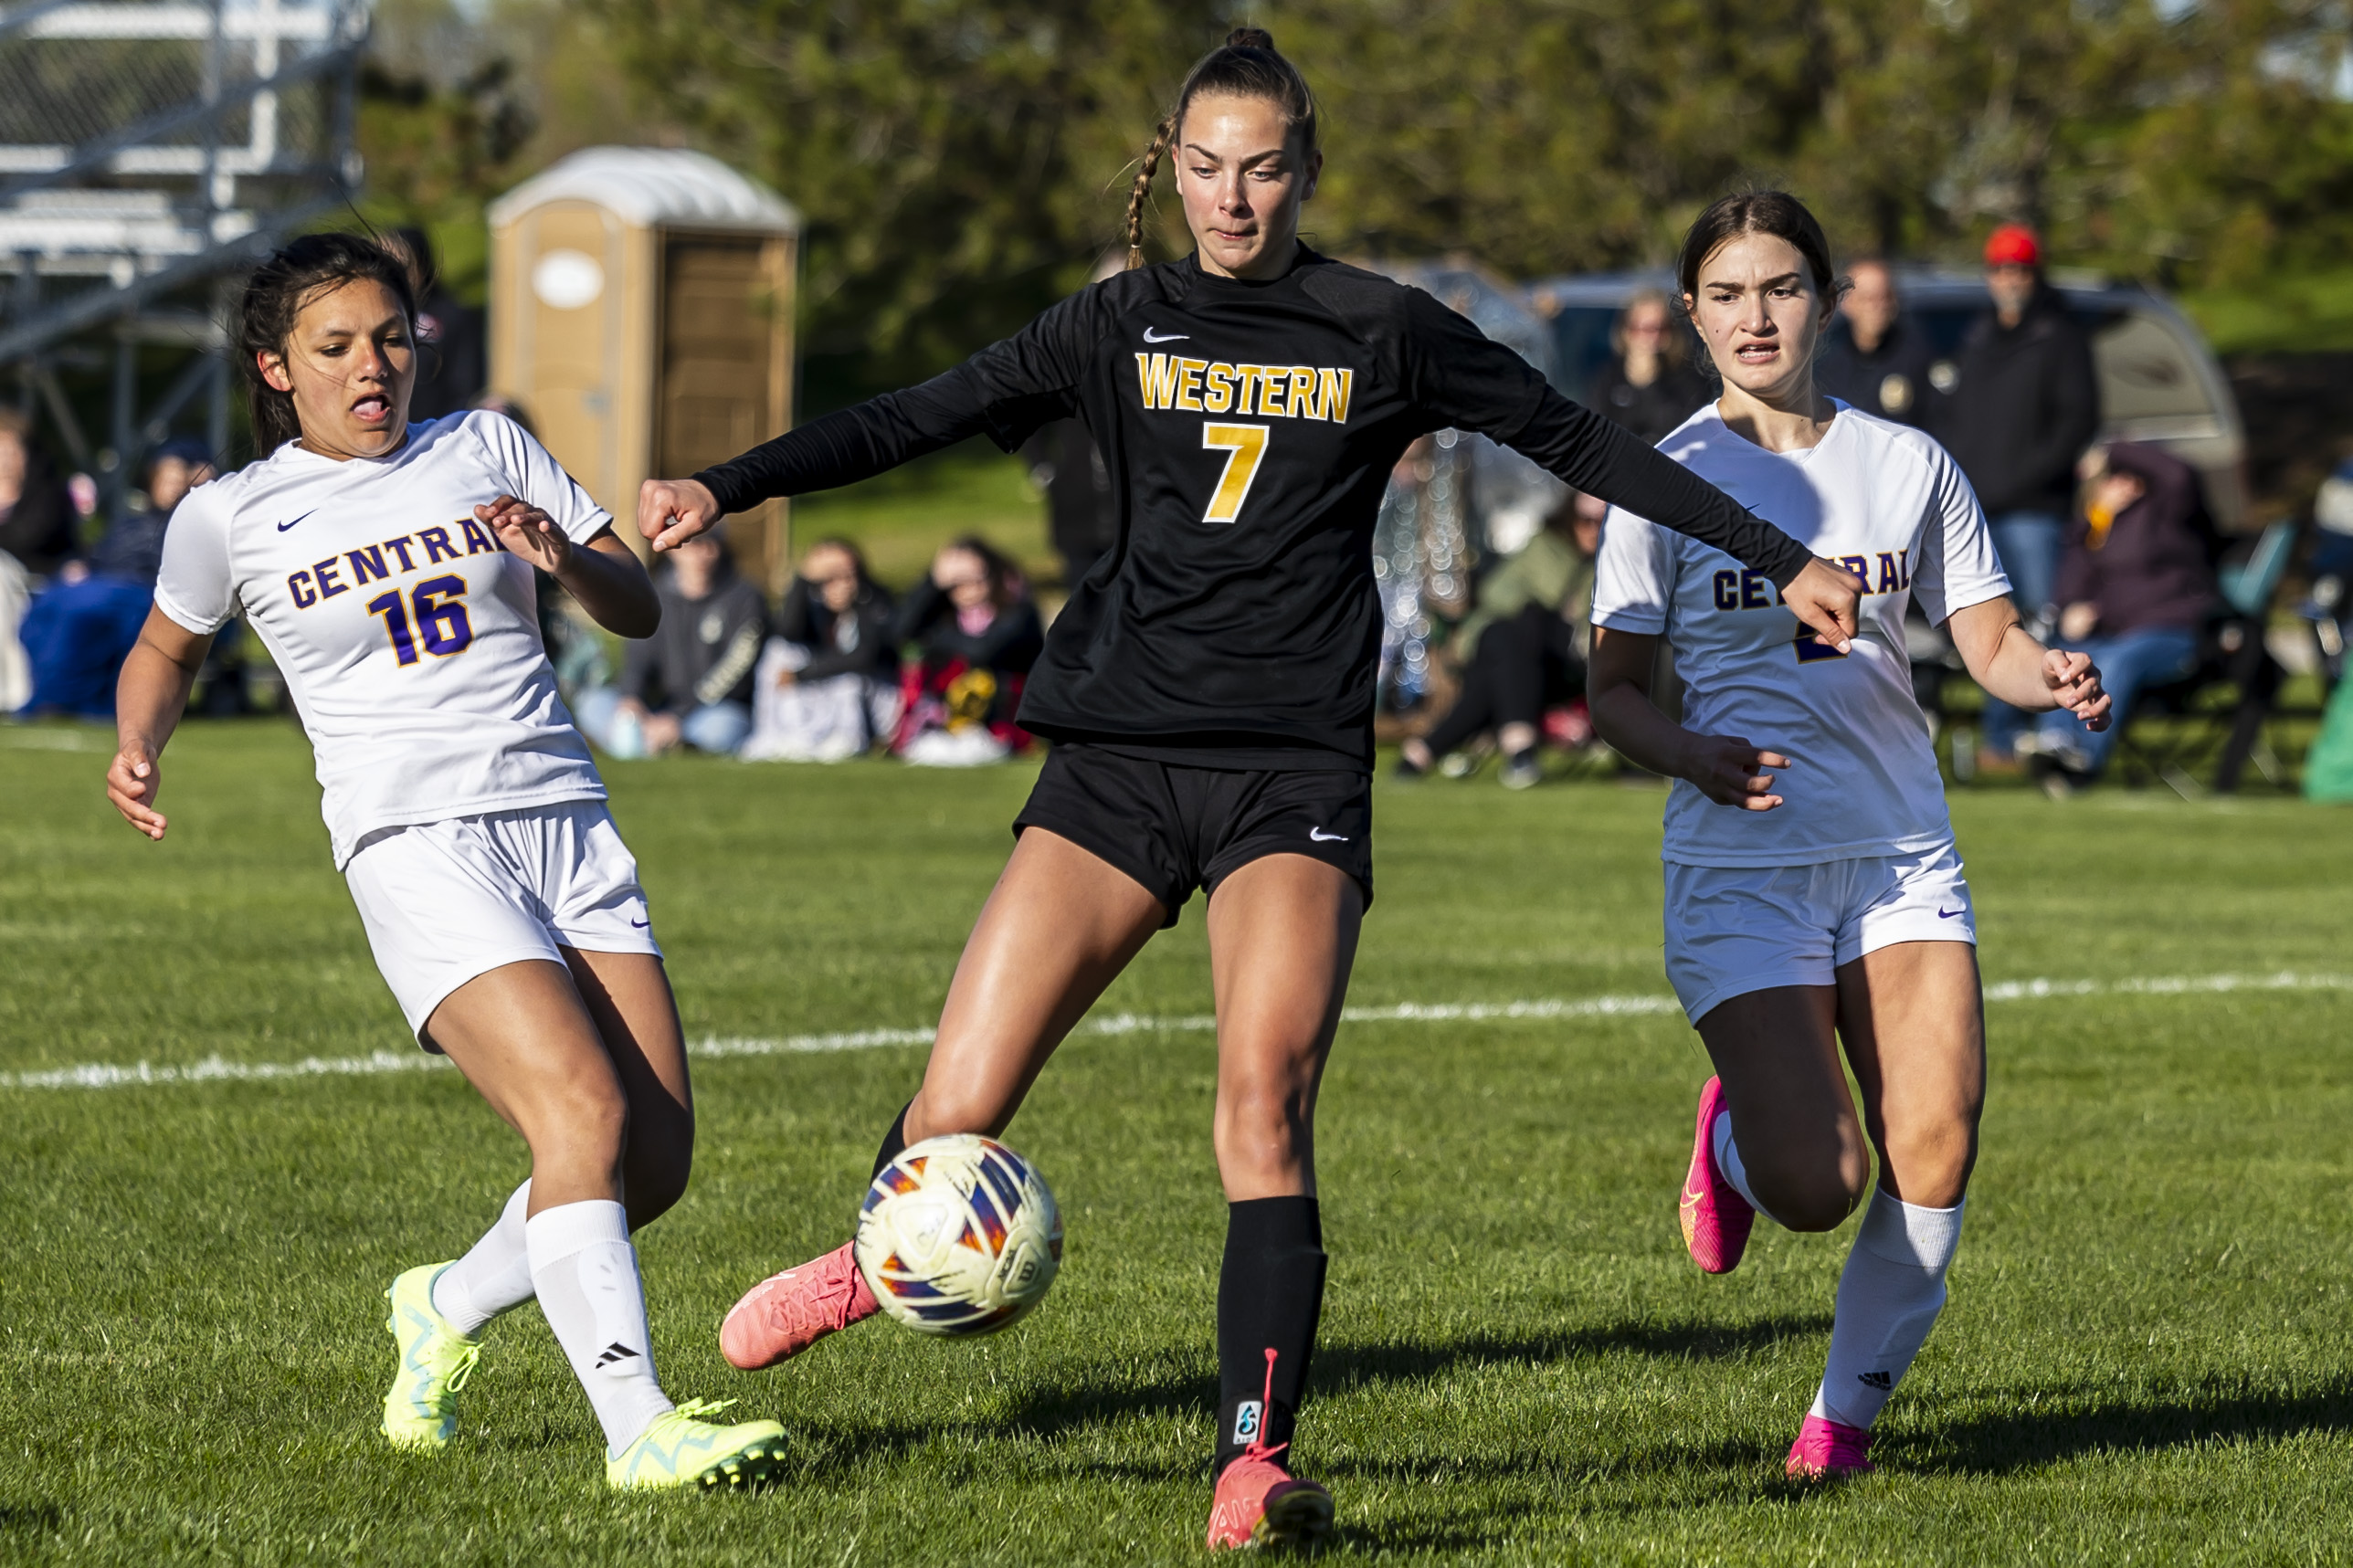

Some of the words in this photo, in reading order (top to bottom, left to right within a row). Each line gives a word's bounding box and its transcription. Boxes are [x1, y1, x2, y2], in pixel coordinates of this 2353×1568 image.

[1134, 353, 1354, 425] WESTERN
[1202, 421, 1271, 524] 7
[287, 517, 510, 611] CENTRA
[1713, 548, 1911, 612] CERAL
[365, 572, 475, 668] 16
